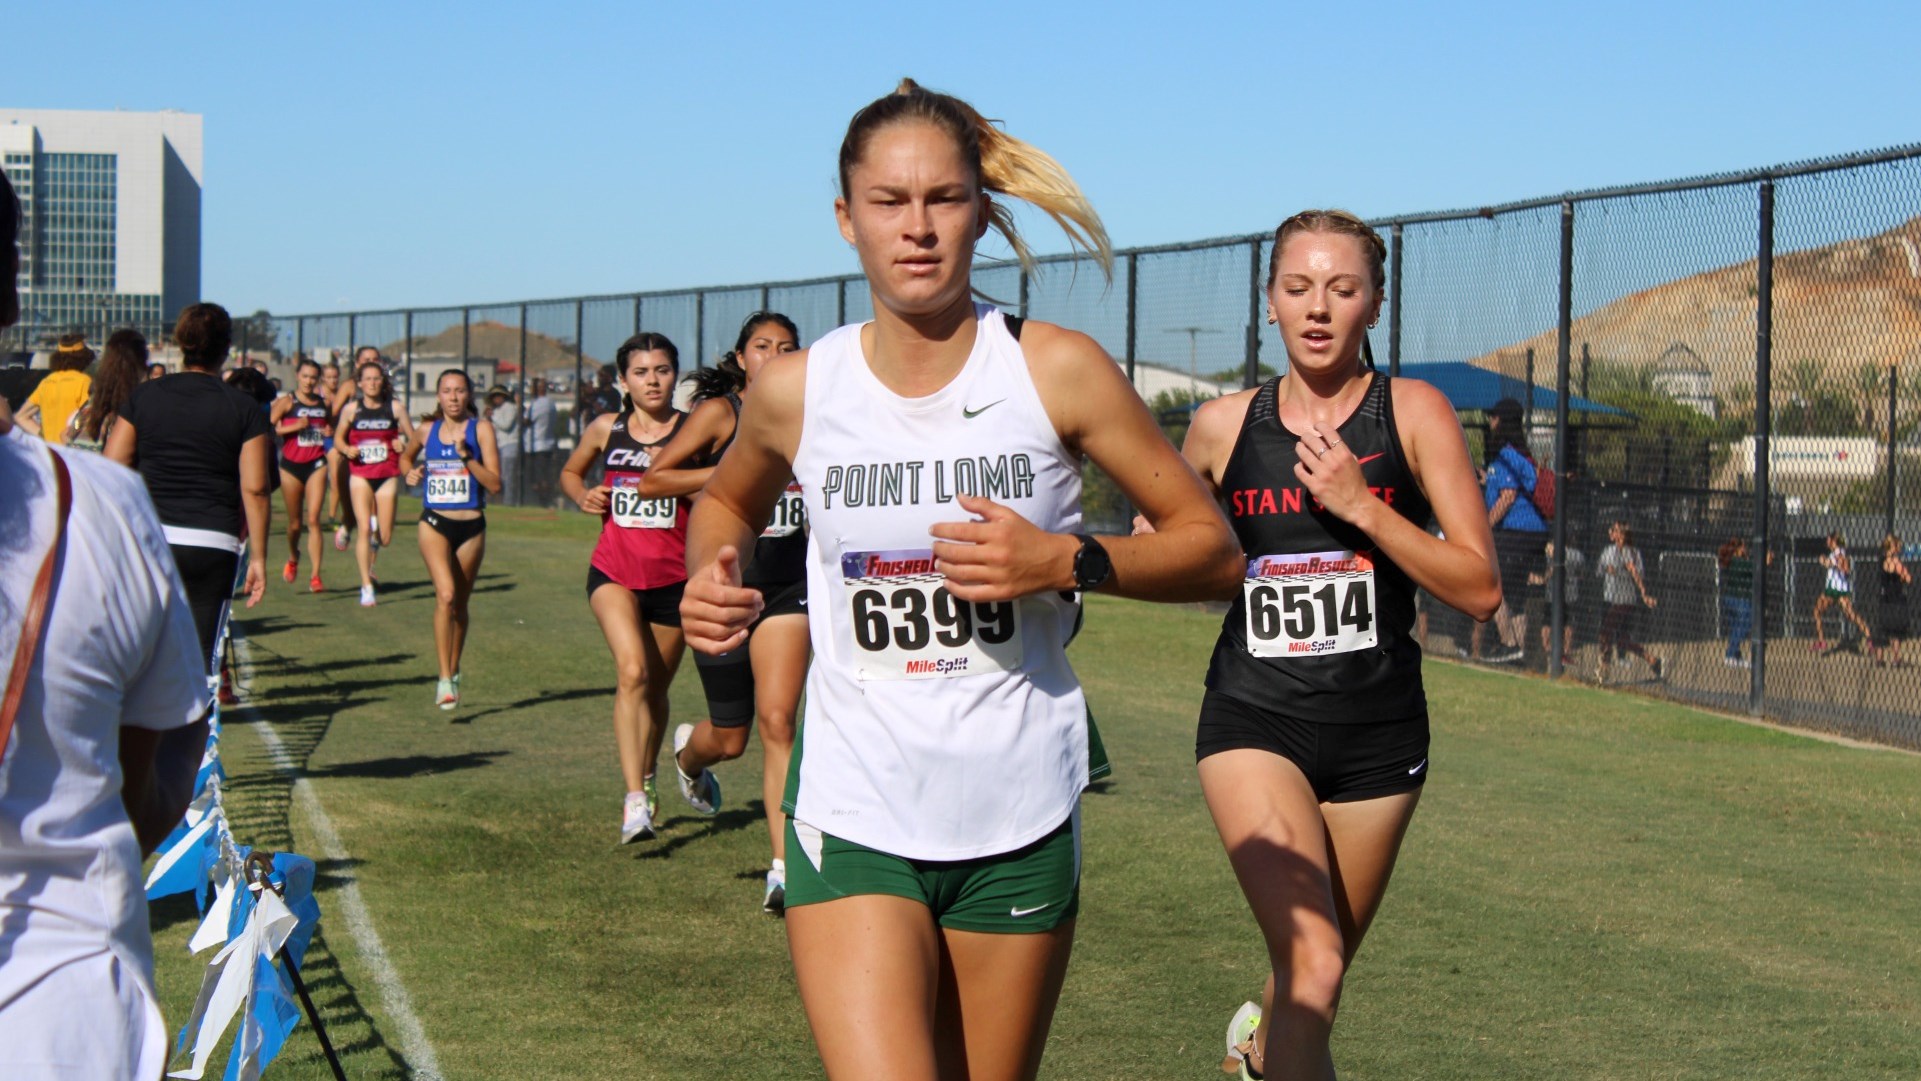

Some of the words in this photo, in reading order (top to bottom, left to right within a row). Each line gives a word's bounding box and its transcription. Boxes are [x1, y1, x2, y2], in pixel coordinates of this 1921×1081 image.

[356, 420, 391, 430] CHICO
[428, 479, 467, 496] 6344
[822, 461, 924, 510] POINT
[934, 453, 1036, 504] LOMA
[614, 491, 674, 519] 6239
[1232, 487, 1302, 517] STAN
[852, 587, 1016, 652] 6399
[1250, 580, 1373, 641] 6514
[1288, 639, 1336, 654] MileSplit
[905, 657, 969, 675] MileSplit
